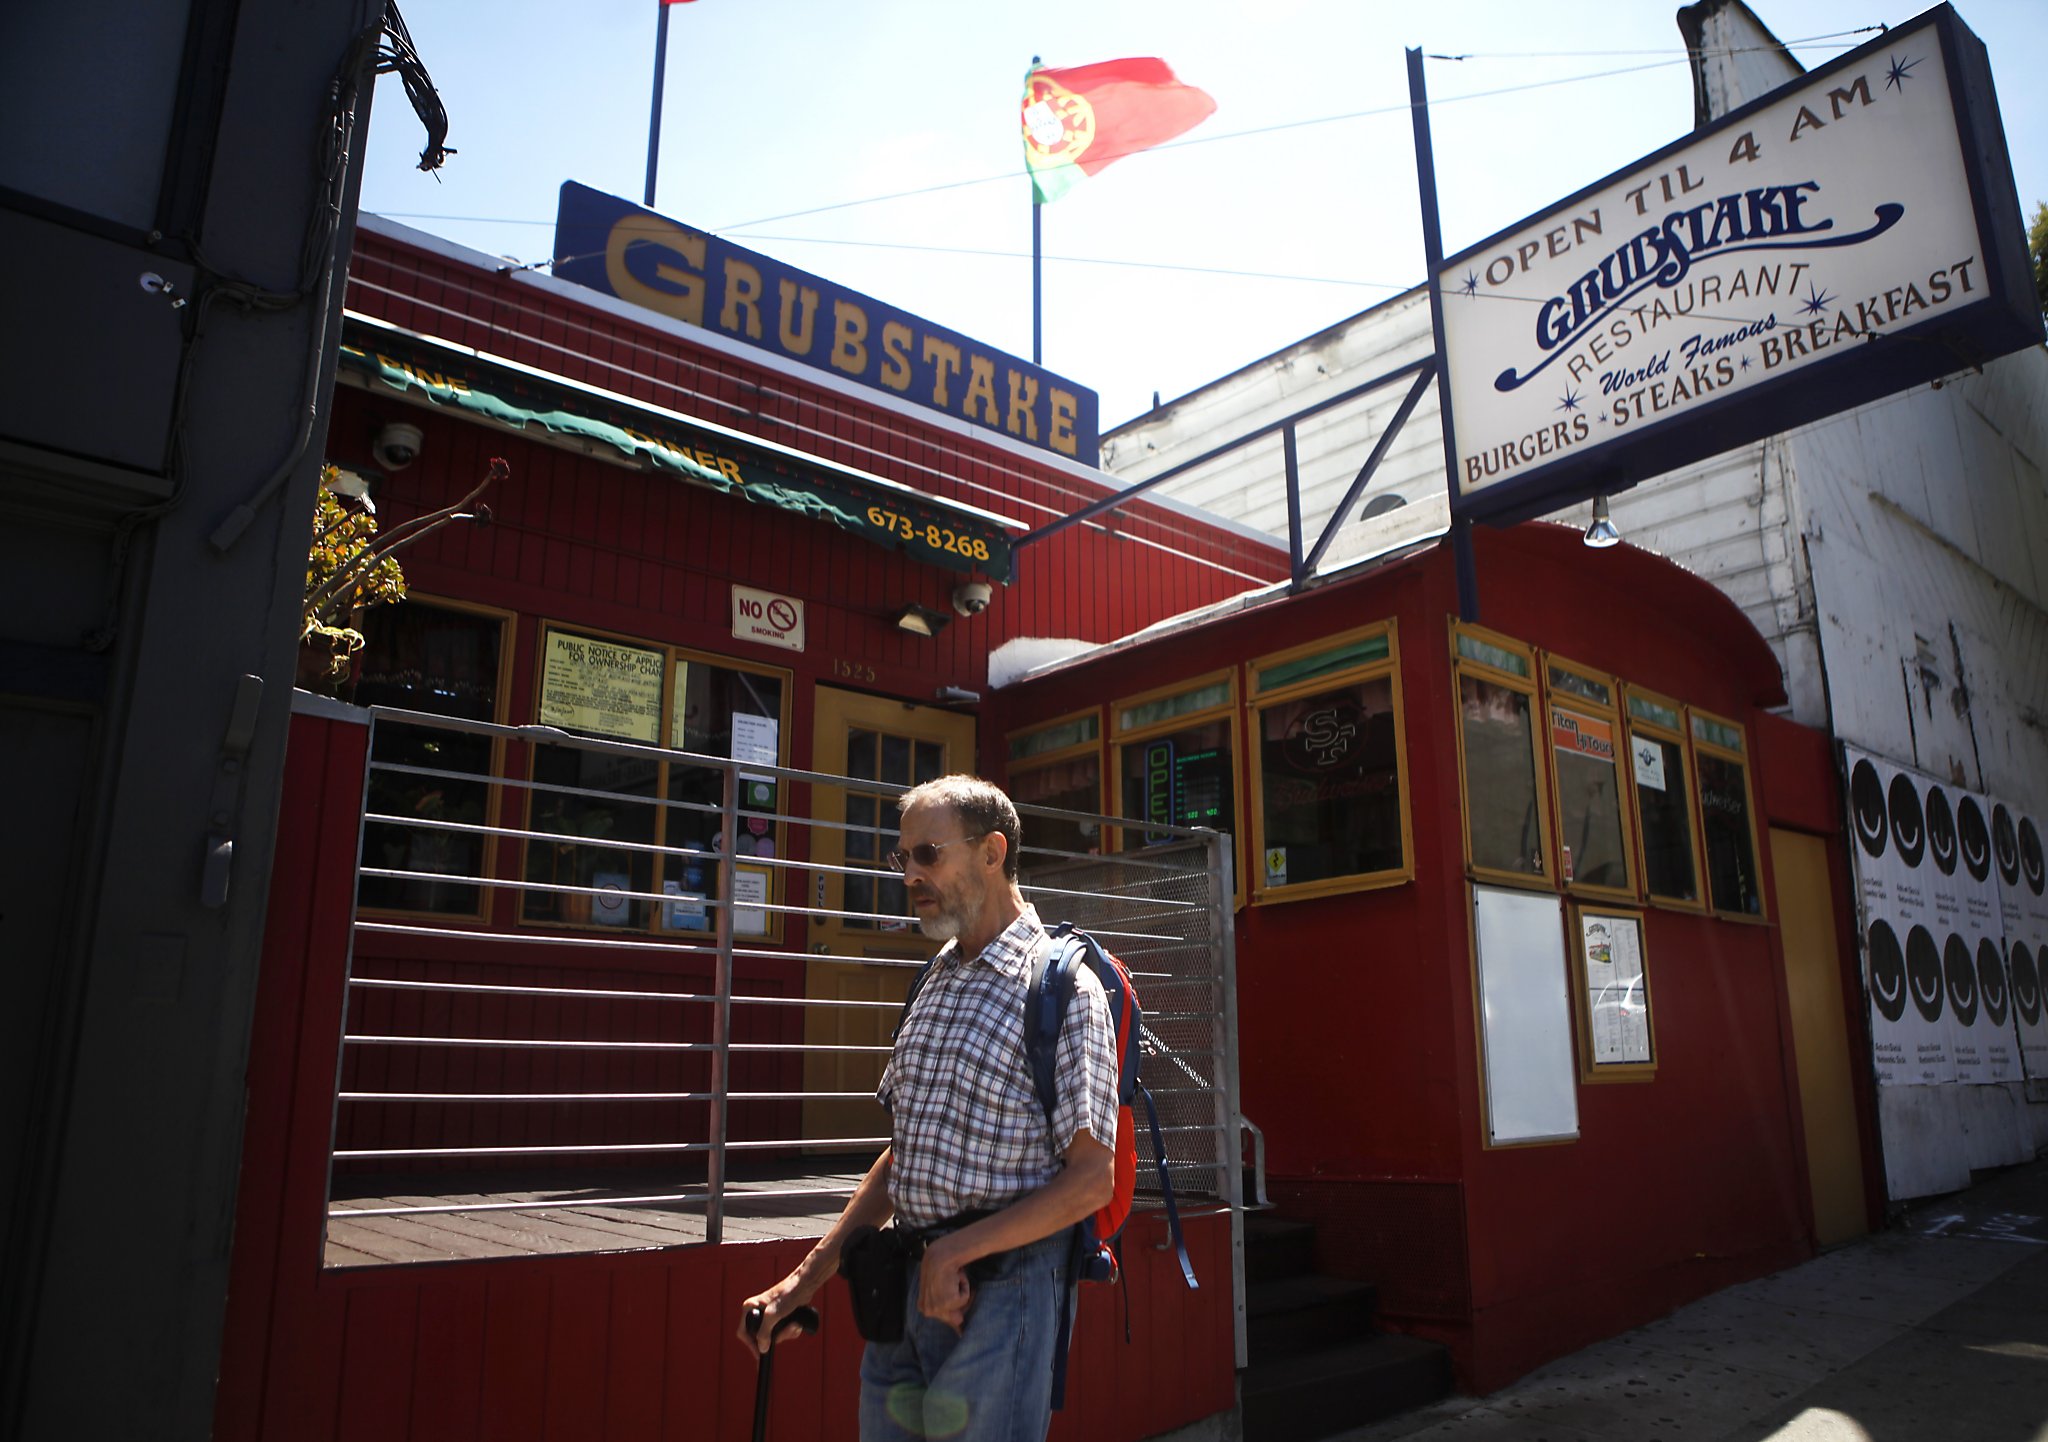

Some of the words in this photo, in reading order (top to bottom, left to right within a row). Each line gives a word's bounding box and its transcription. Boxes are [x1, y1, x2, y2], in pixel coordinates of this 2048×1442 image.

[1485, 209, 1602, 286] OPEN
[1625, 166, 1704, 216] TIL
[1729, 131, 1761, 165] 4
[1790, 75, 1877, 142] AM
[1536, 181, 1833, 351] GRUBSTAKE
[606, 214, 1078, 456] GRUBSTAKE
[1567, 263, 1810, 383] RESTAURANT
[1600, 350, 1670, 396] World
[1680, 313, 1777, 369] Famous
[1465, 413, 1589, 483] BURGERS
[1612, 356, 1735, 427] STEAKS
[1760, 256, 1975, 370] BREAKFAST
[867, 506, 990, 561] 673-8268
[557, 639, 585, 653] PUBLIC
[588, 646, 617, 661] NOTICE
[621, 652, 632, 662] OF
[739, 598, 762, 620] NO
[751, 626, 785, 640] SMOKING
[568, 651, 585, 662] FOR
[588, 656, 636, 672] OWNERSHIP
[832, 657, 876, 683] 1525
[1151, 748, 1168, 839] OPEN
